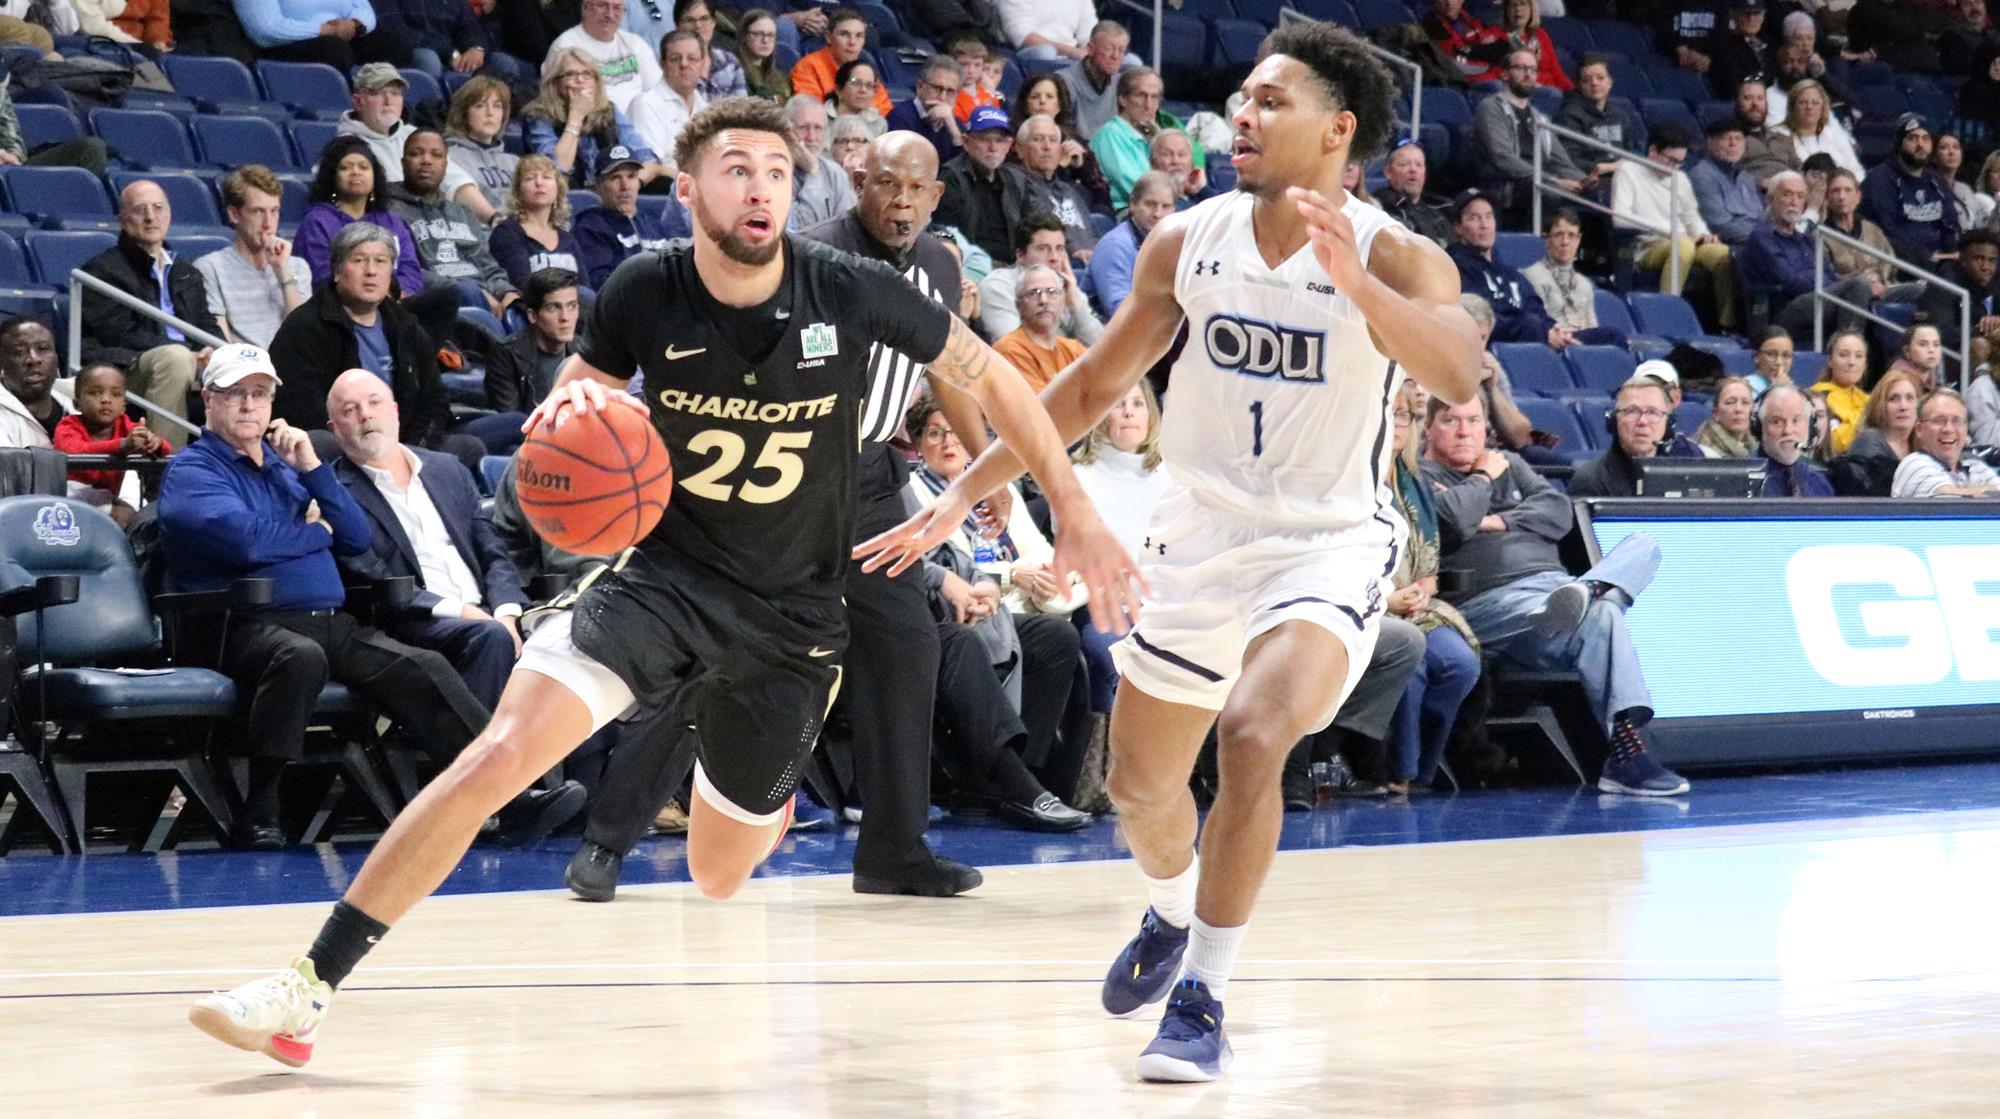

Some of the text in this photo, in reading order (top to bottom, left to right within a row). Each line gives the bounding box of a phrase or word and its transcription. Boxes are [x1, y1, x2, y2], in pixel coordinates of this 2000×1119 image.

[806, 342, 833, 353] NINERS
[1206, 314, 1327, 384] ODU
[660, 390, 838, 424] CHARLOTTE
[1249, 401, 1262, 457] 1
[515, 459, 571, 493] ilson
[678, 429, 813, 504] 25
